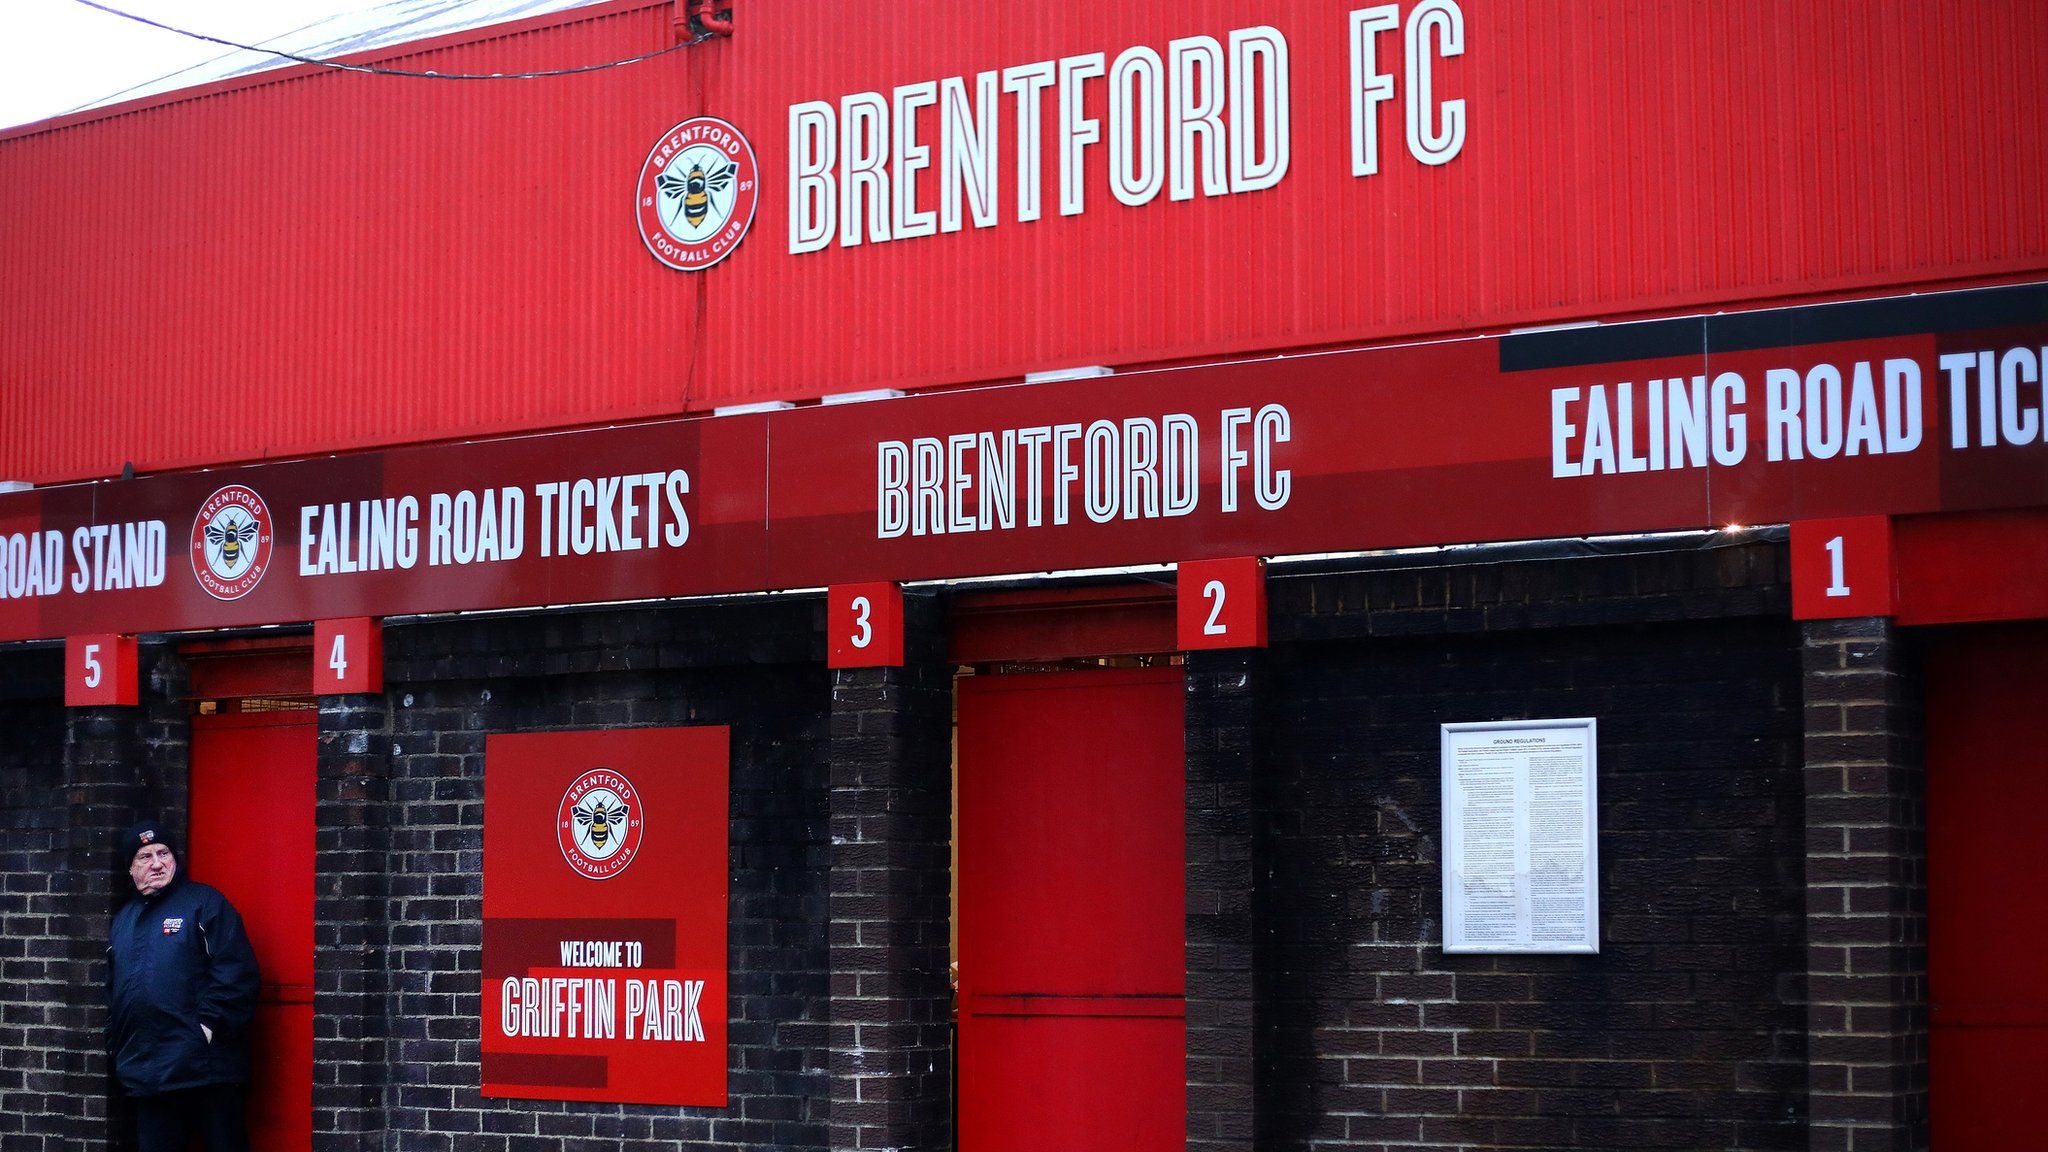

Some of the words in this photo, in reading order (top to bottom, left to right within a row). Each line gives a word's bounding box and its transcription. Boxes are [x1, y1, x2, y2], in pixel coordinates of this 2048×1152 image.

[653, 126, 741, 168] BRENTFORD
[788, 25, 1290, 255] BRENTFORD
[1349, 0, 1466, 177] FC
[642, 196, 653, 207] 18
[740, 180, 753, 192] 89
[652, 232, 710, 262] FOOTBALL
[712, 220, 742, 253] CLUB
[1551, 371, 1747, 479] EALING
[1766, 357, 1923, 462] ROAD
[1939, 346, 2048, 449] TIC
[877, 413, 1199, 539] BRENTFORD
[1221, 403, 1291, 513] FC
[203, 491, 262, 520] BRENTFORD
[299, 495, 419, 577] EALING
[429, 486, 525, 567] ROAD
[535, 469, 690, 558] TICKETS
[71, 519, 166, 594] STAND
[194, 542, 202, 550] 18
[260, 535, 270, 543] 89
[201, 570, 240, 594] FOOTBALL
[241, 565, 261, 588] CLUB
[1825, 536, 1850, 597] 1
[850, 596, 872, 648] 3
[1203, 580, 1227, 636] 2
[84, 644, 101, 688] 5
[329, 634, 348, 680] 4
[570, 775, 631, 801] BRENTFORD
[561, 821, 569, 829] 18
[630, 819, 640, 827] 89
[568, 848, 609, 874] FOOTBALL
[611, 847, 631, 869] CLUB
[560, 940, 623, 968] WELCOME
[625, 941, 642, 968] TO
[501, 976, 616, 1040] GRIFFIN
[625, 979, 706, 1042] PARK
